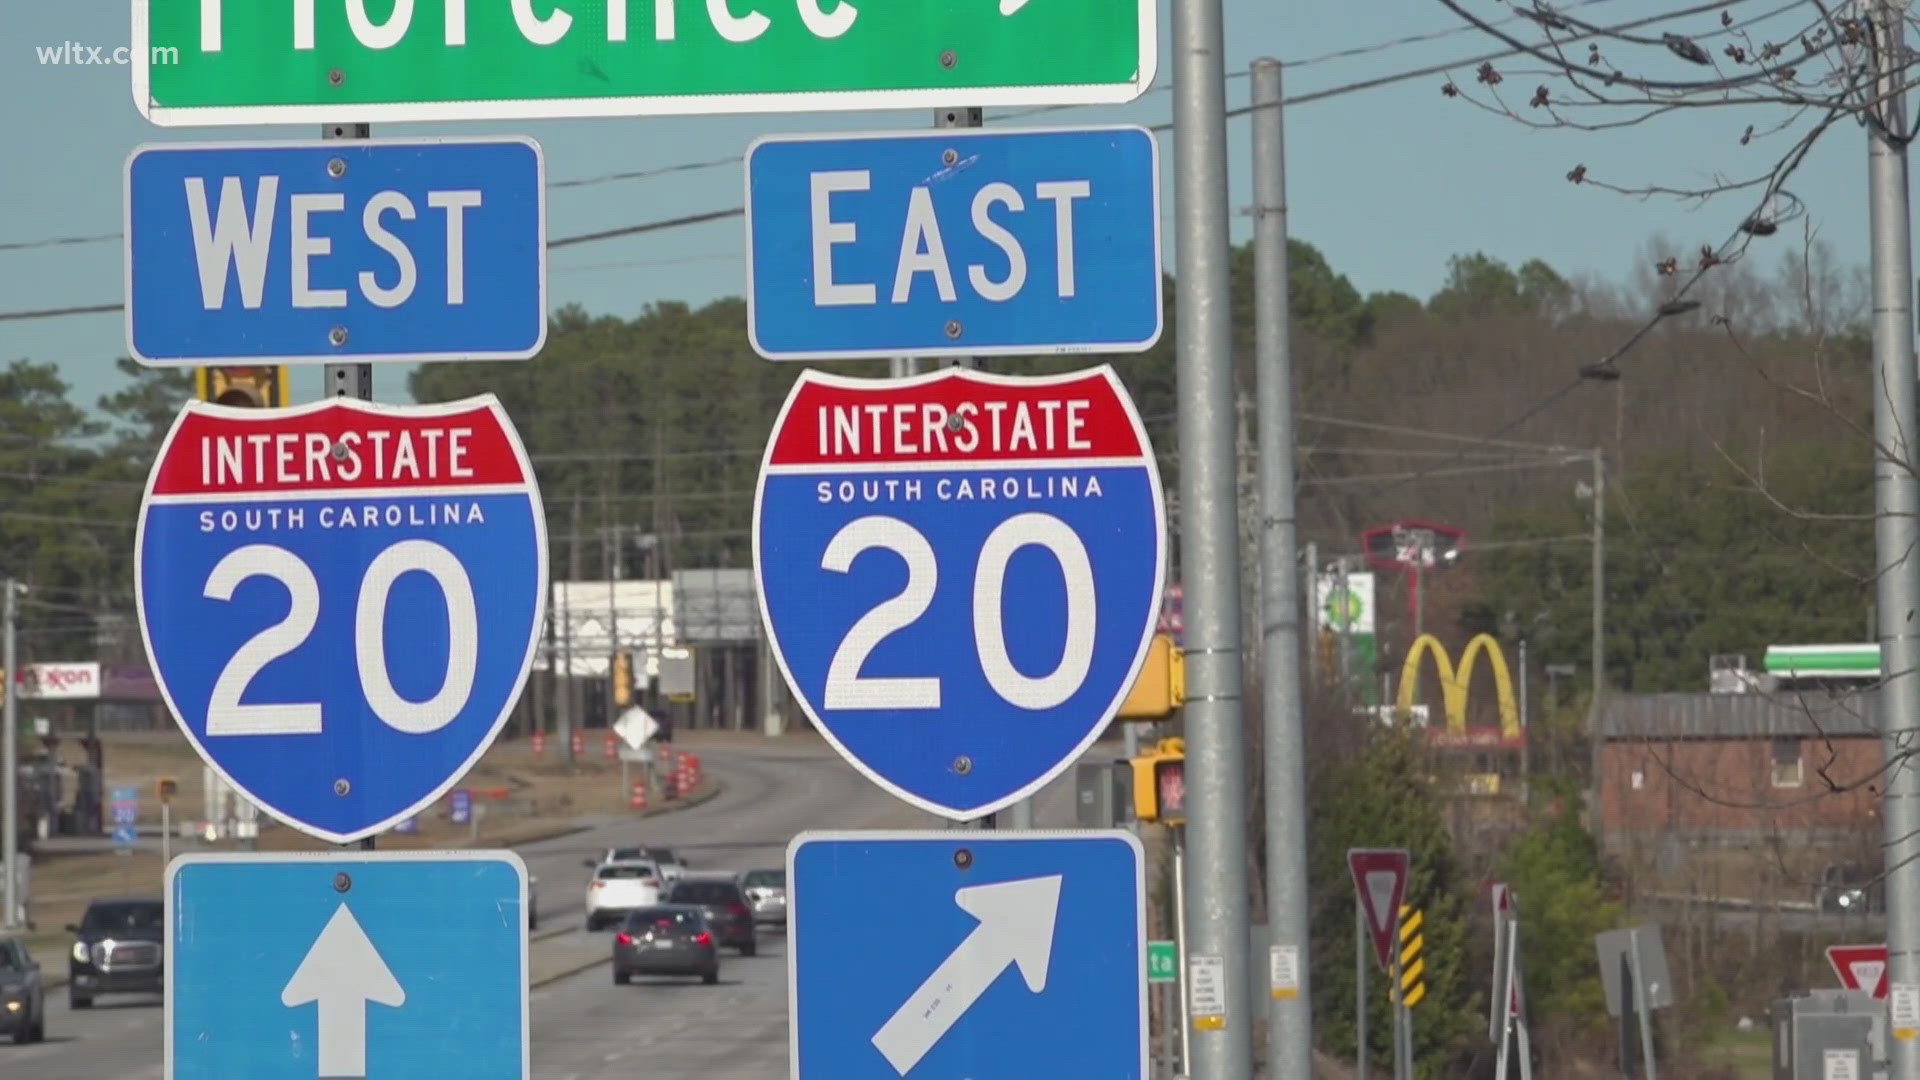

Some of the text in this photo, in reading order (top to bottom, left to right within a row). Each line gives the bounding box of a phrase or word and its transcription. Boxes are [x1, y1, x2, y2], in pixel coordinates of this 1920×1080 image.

[184, 175, 482, 310] WEST
[810, 169, 1091, 307] EAST
[202, 428, 473, 486] INTERSTATE
[818, 399, 1092, 456] INTERSTATE
[200, 502, 485, 532] SOUTH CAROLINA
[817, 475, 1103, 503] SOUTH CAROLINA
[202, 538, 479, 737] 20
[821, 511, 1097, 711] 20
